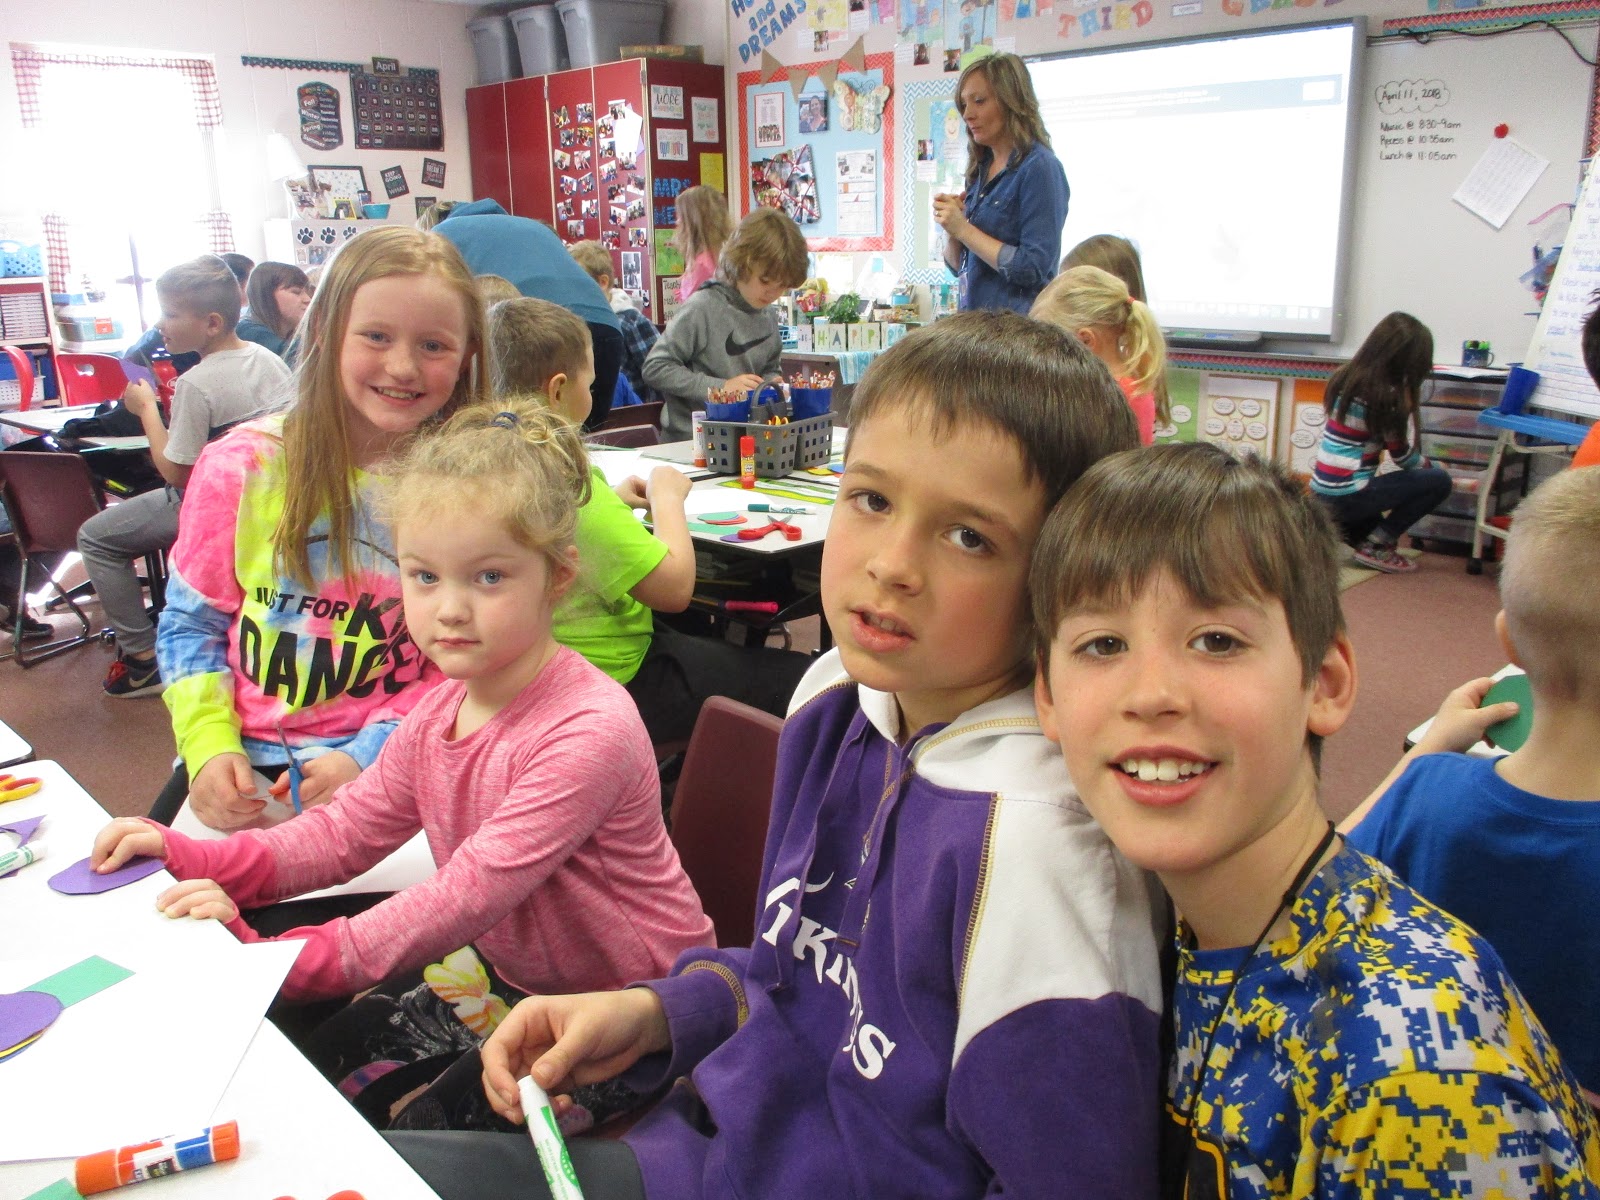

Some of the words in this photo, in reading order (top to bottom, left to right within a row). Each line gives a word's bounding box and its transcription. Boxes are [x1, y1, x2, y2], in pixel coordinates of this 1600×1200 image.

[749, 0, 775, 31] and
[1056, 0, 1154, 38] THIRD
[738, 0, 807, 64] DREAMS
[375, 61, 397, 73] April
[656, 93, 680, 105] MORE
[1382, 90, 1401, 104] April
[1422, 87, 1442, 99] 2018
[303, 98, 316, 107] Fall
[301, 109, 320, 120] Winter
[302, 124, 321, 132] Spring
[302, 134, 325, 147] Summer
[1380, 151, 1403, 160] Lunch
[384, 170, 396, 178] KEEP
[384, 174, 402, 183] GOING
[388, 185, 406, 195] WHAT
[817, 328, 886, 347] HAPP
[255, 587, 295, 612] JUST
[296, 595, 350, 621] FOR
[344, 592, 406, 640] KI
[239, 614, 414, 708] DANCE
